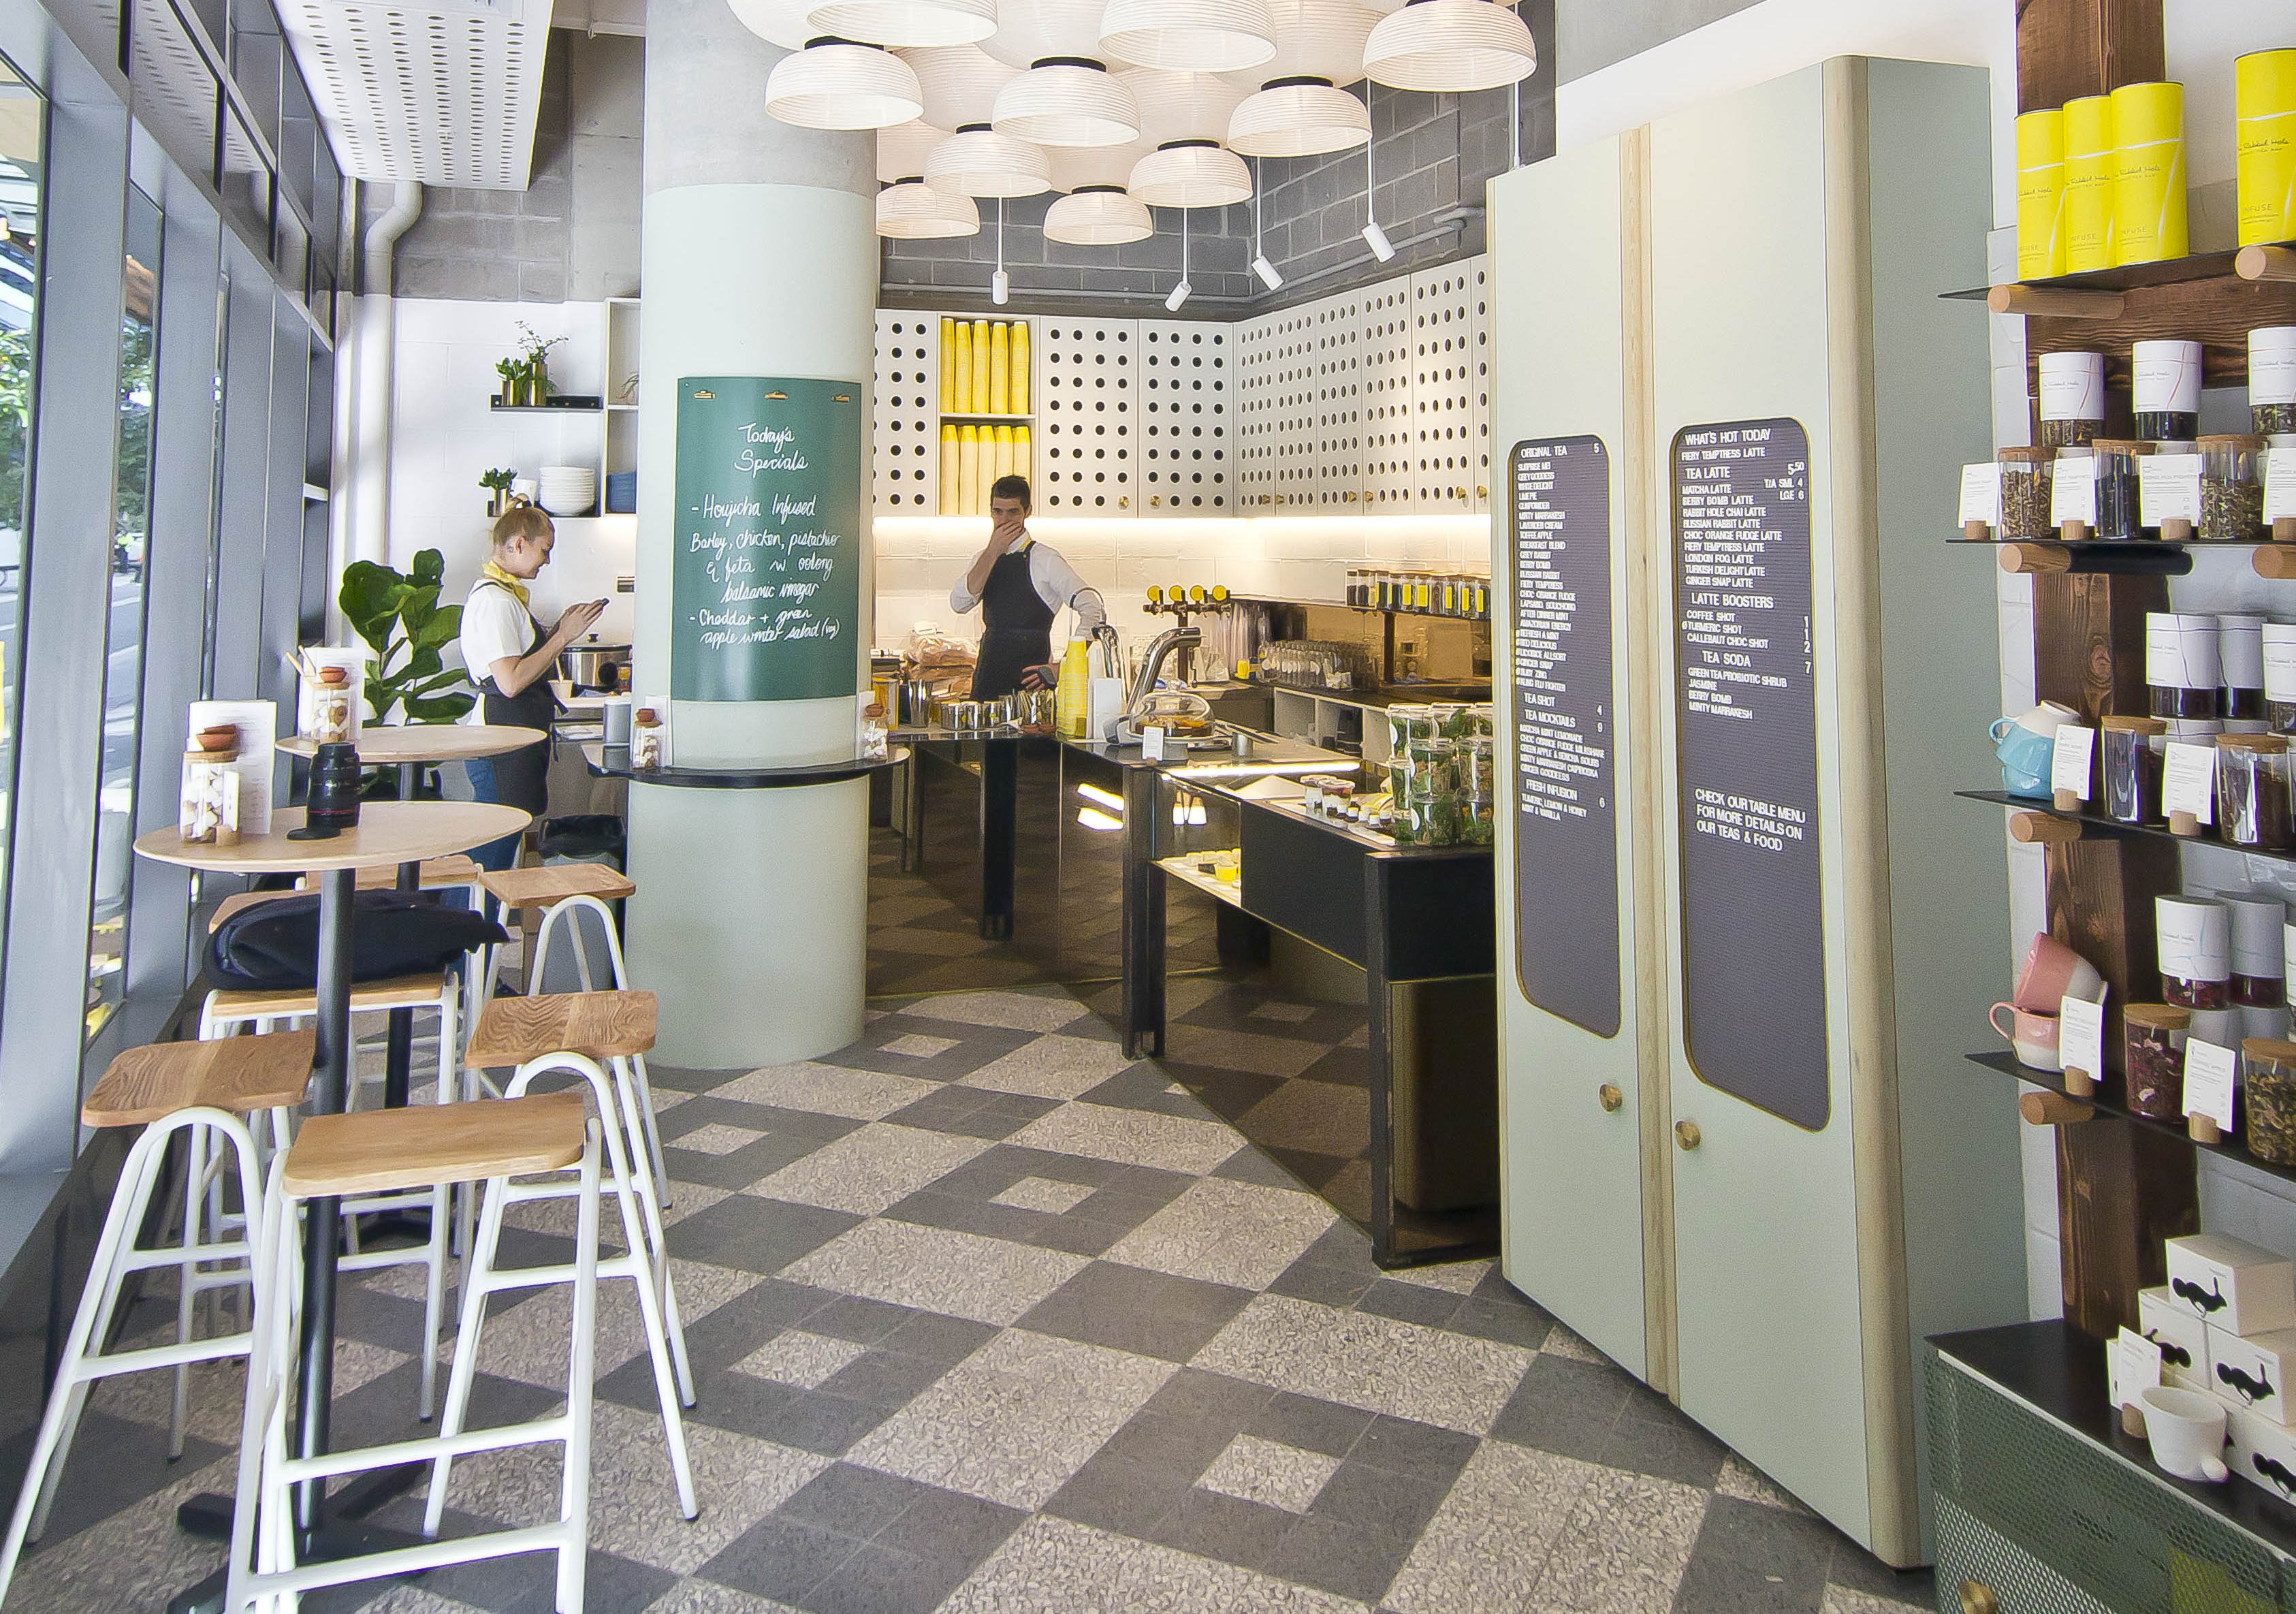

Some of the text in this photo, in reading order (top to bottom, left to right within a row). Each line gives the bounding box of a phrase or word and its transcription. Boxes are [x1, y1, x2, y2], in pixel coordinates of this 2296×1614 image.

[737, 423, 795, 454] Today's
[1685, 428, 1771, 445] WHAT'S HOT TODAY
[1520, 443, 1599, 458] ORIGINAL TEA 5
[1682, 447, 1766, 460] FIERY TEMPTRESS LATTE
[734, 449, 808, 478] Specials
[1685, 466, 1730, 479] TEA LATTE
[1682, 484, 1732, 494] MATCHA LATTE
[1797, 478, 1803, 487] 4
[1732, 495, 1754, 505] LATTE
[1779, 490, 1804, 500] LGE 6
[772, 493, 816, 525] Infused
[1707, 507, 1725, 517] HOLE
[1726, 507, 1743, 517] CHAI
[1744, 507, 1767, 517] LATTE
[1738, 518, 1761, 528] LATTE
[1683, 531, 1783, 541] CHOC ORANGE FUDGE LATTE
[1704, 542, 1742, 552] TEMPTRESS
[1743, 543, 1766, 552] LATTE
[1685, 554, 1754, 564] LONDON FOG LATTE
[725, 556, 755, 582] feta
[798, 552, 833, 582] oolong
[1685, 565, 1766, 577] TURKISH DELIGHT LATTE
[1685, 576, 1754, 588] GINGER SNAP LATTE
[720, 577, 819, 604] balsamic vinegar
[1691, 592, 1774, 609] LATTE BOOSTERS
[699, 608, 756, 626] Cheddar
[775, 609, 813, 632] green
[1687, 610, 1736, 622] COFFEE SHOT
[700, 629, 737, 650] apple
[738, 626, 784, 645] winter
[784, 618, 820, 641] salad
[1688, 622, 1721, 633] TURMERIC
[1723, 624, 1742, 635] SHOT
[1687, 633, 1770, 649] CALLEBAUT CHOC SHOT
[1804, 641, 1811, 653] 2
[1702, 650, 1751, 667] TEA SODA
[1804, 662, 1811, 674] 7
[1688, 667, 1787, 688] GREEN TEA PROBIOTIC SHRUB
[1689, 679, 1717, 691] JASMINE
[1524, 692, 1555, 707] TEA SHOT
[1597, 704, 1602, 716] 4
[1689, 701, 1753, 720] MINTY MARRAKESH
[1525, 709, 1576, 728] TEA MOCKTAILS
[1526, 778, 1578, 801] FRESH INFUSION
[1695, 789, 1806, 823] CHECK OUR TABLE MENU
[1696, 804, 1803, 840] FOR MORE DETAILS ON
[1696, 820, 1783, 851] OUR TEAS & FOOD
